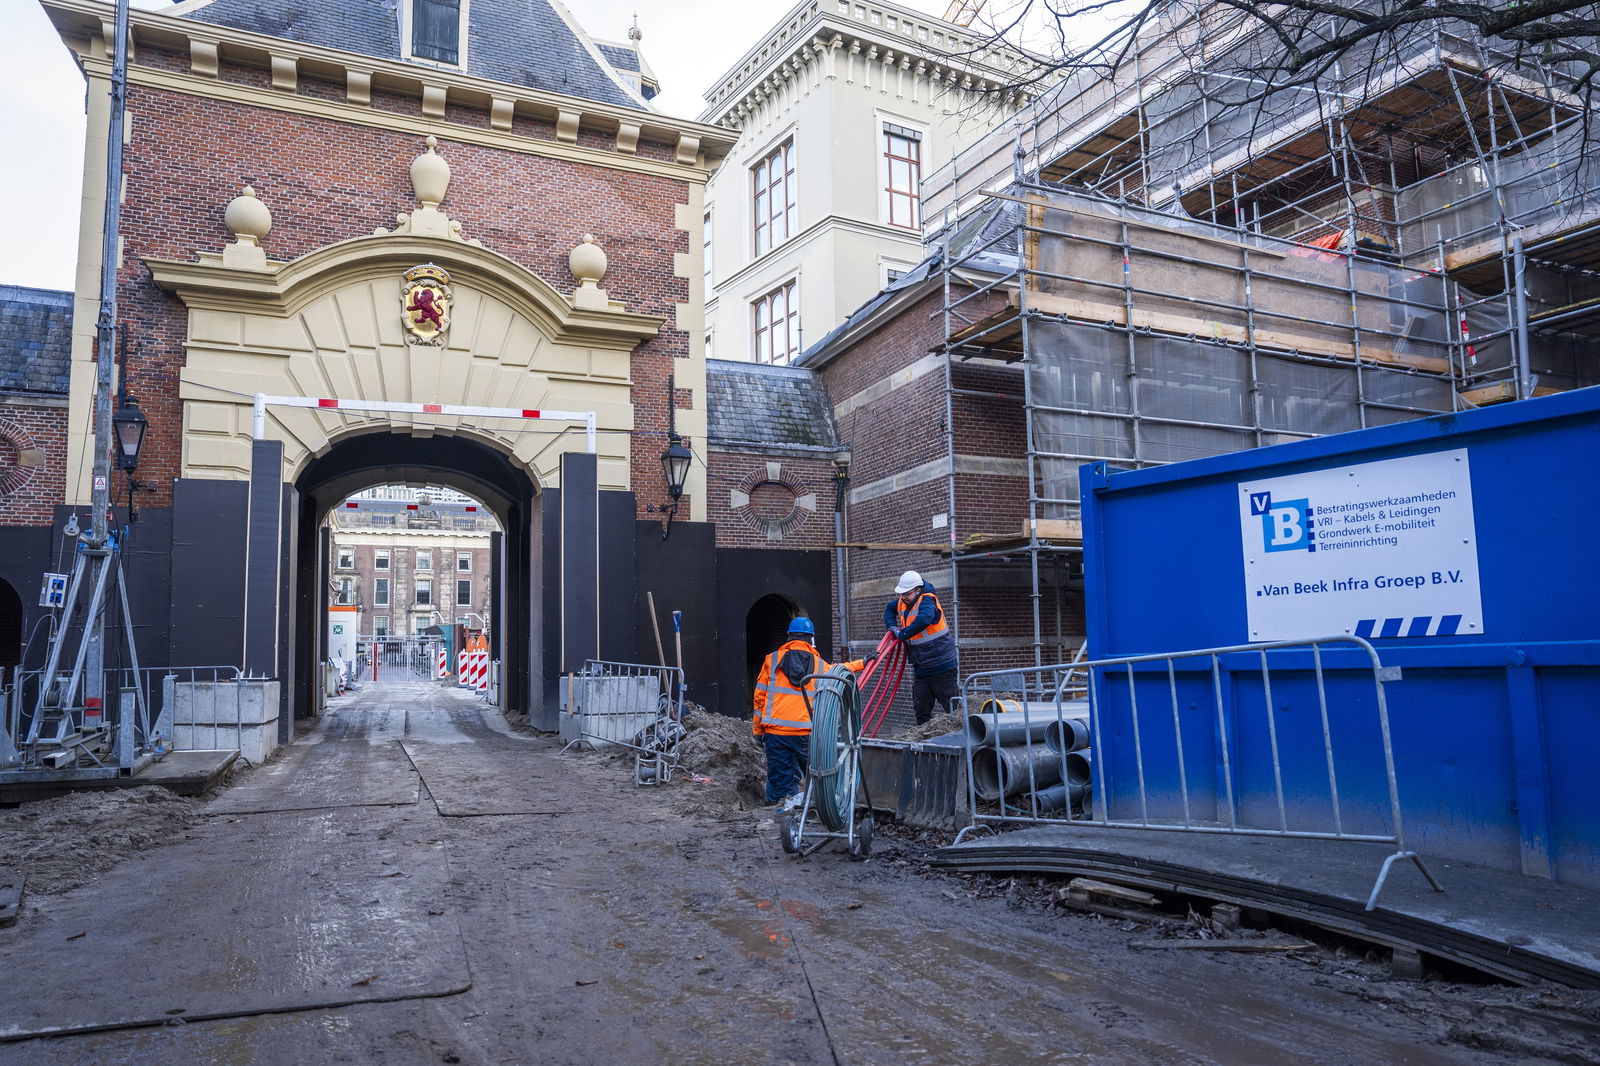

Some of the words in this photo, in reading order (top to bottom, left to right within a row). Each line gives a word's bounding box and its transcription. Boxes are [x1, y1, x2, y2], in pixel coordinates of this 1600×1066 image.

[1253, 495, 1267, 512] V
[1317, 490, 1456, 515] Bestratingswerkzaamheden
[1318, 517, 1333, 526] VRI
[1344, 512, 1375, 524] Kabels
[1378, 510, 1386, 519] &
[1389, 505, 1441, 520] Leidingen
[1269, 507, 1302, 546] B
[1319, 523, 1371, 539] Grondwerk
[1375, 519, 1435, 533] E-mobiliteit
[1320, 536, 1398, 551] Terreininrichting
[1263, 583, 1289, 596] Van
[1294, 580, 1328, 594] Beek
[1333, 578, 1369, 591] Infra
[1374, 575, 1425, 589] Groep
[1432, 570, 1463, 585] B.V.
